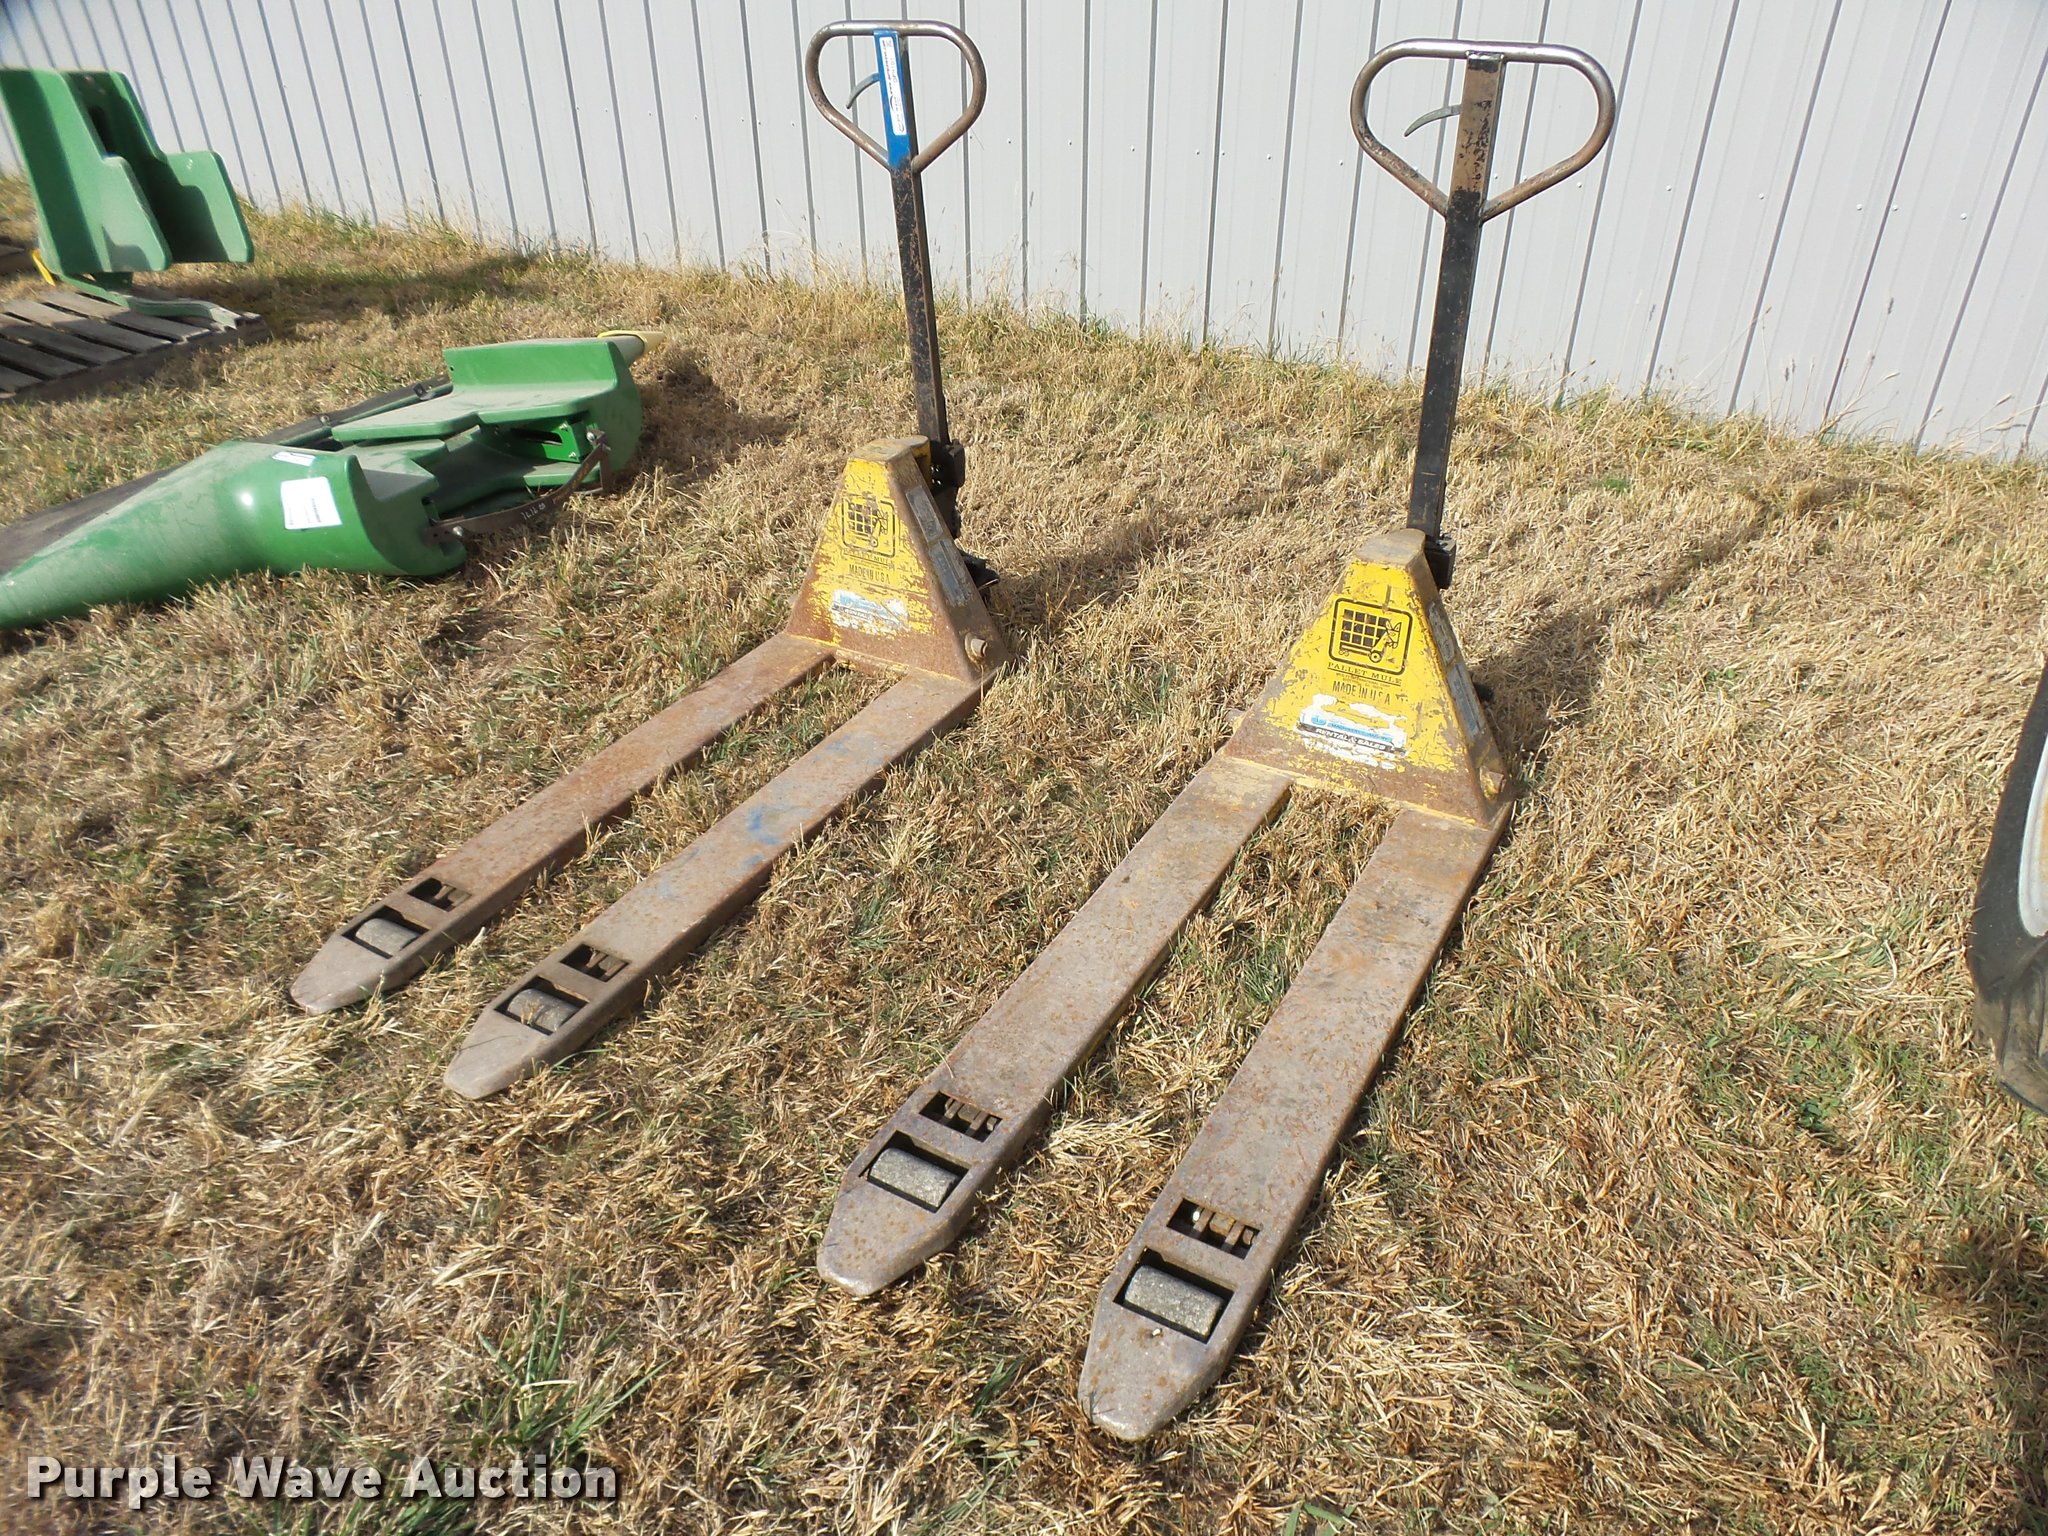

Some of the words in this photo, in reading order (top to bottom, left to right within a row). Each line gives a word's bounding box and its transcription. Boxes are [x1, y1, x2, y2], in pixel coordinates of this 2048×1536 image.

[1328, 661, 1368, 676] PALLET
[1371, 672, 1402, 685] MULE
[1332, 680, 1357, 697] MADE
[1315, 728, 1349, 741] RENTAL
[1357, 739, 1386, 750] SALES
